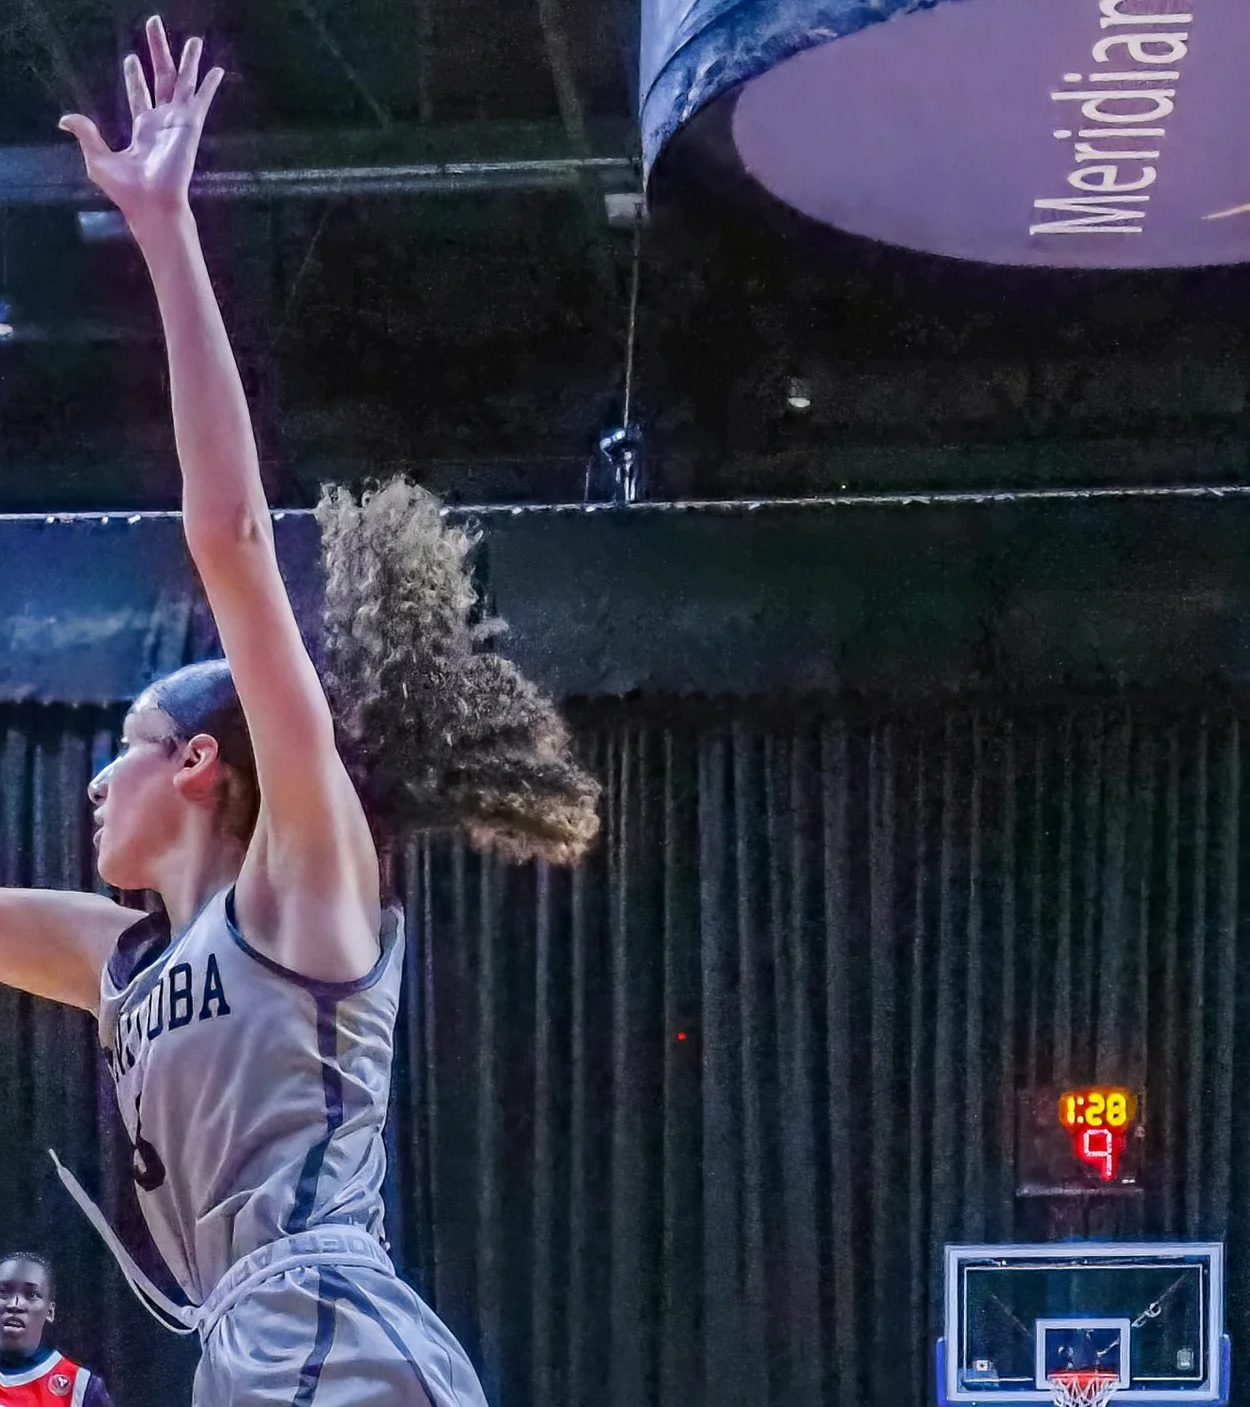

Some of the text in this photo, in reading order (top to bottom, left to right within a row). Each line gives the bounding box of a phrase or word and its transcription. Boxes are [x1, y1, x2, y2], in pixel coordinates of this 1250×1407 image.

[1029, 0, 1194, 235] Meridian
[1066, 1092, 1127, 1126] 1:28
[1082, 1128, 1112, 1177] 9
